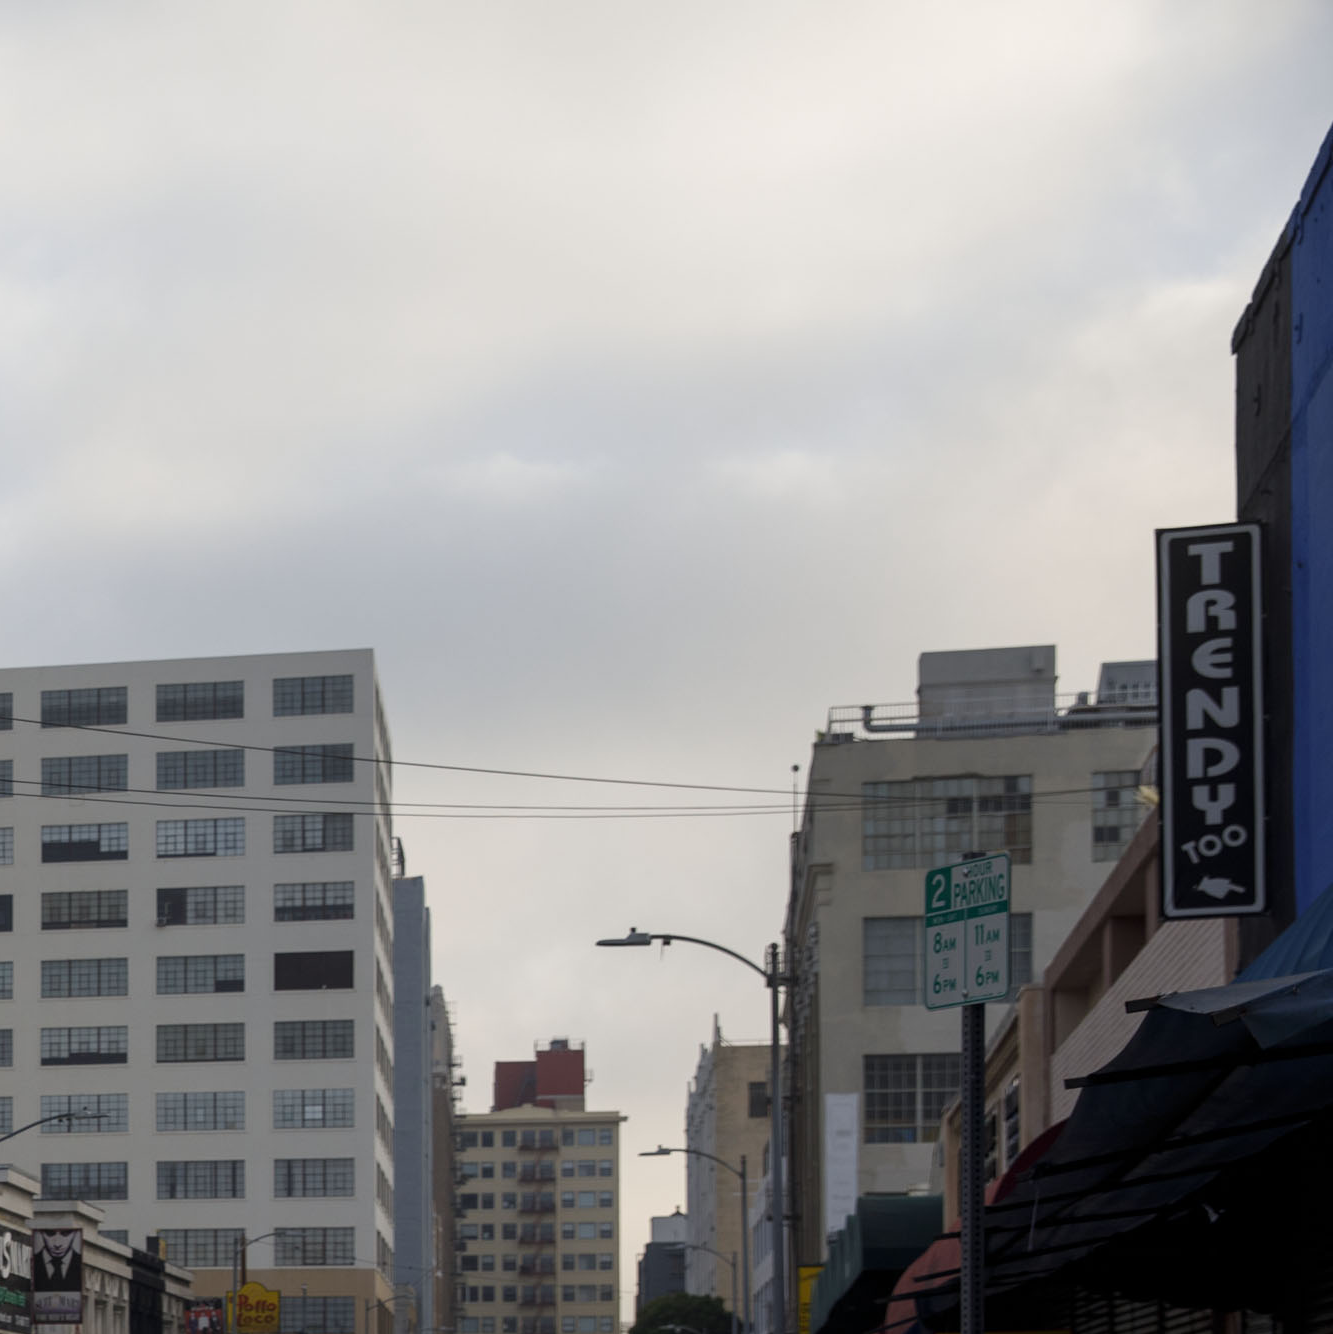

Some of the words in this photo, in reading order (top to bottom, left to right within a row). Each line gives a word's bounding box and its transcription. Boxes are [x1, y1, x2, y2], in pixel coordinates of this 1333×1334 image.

[1185, 541, 1240, 825] TRENDY
[1181, 824, 1248, 864] TOO
[931, 874, 947, 908] 2
[954, 873, 1005, 907] PARKING
[237, 1313, 274, 1328] Loco
